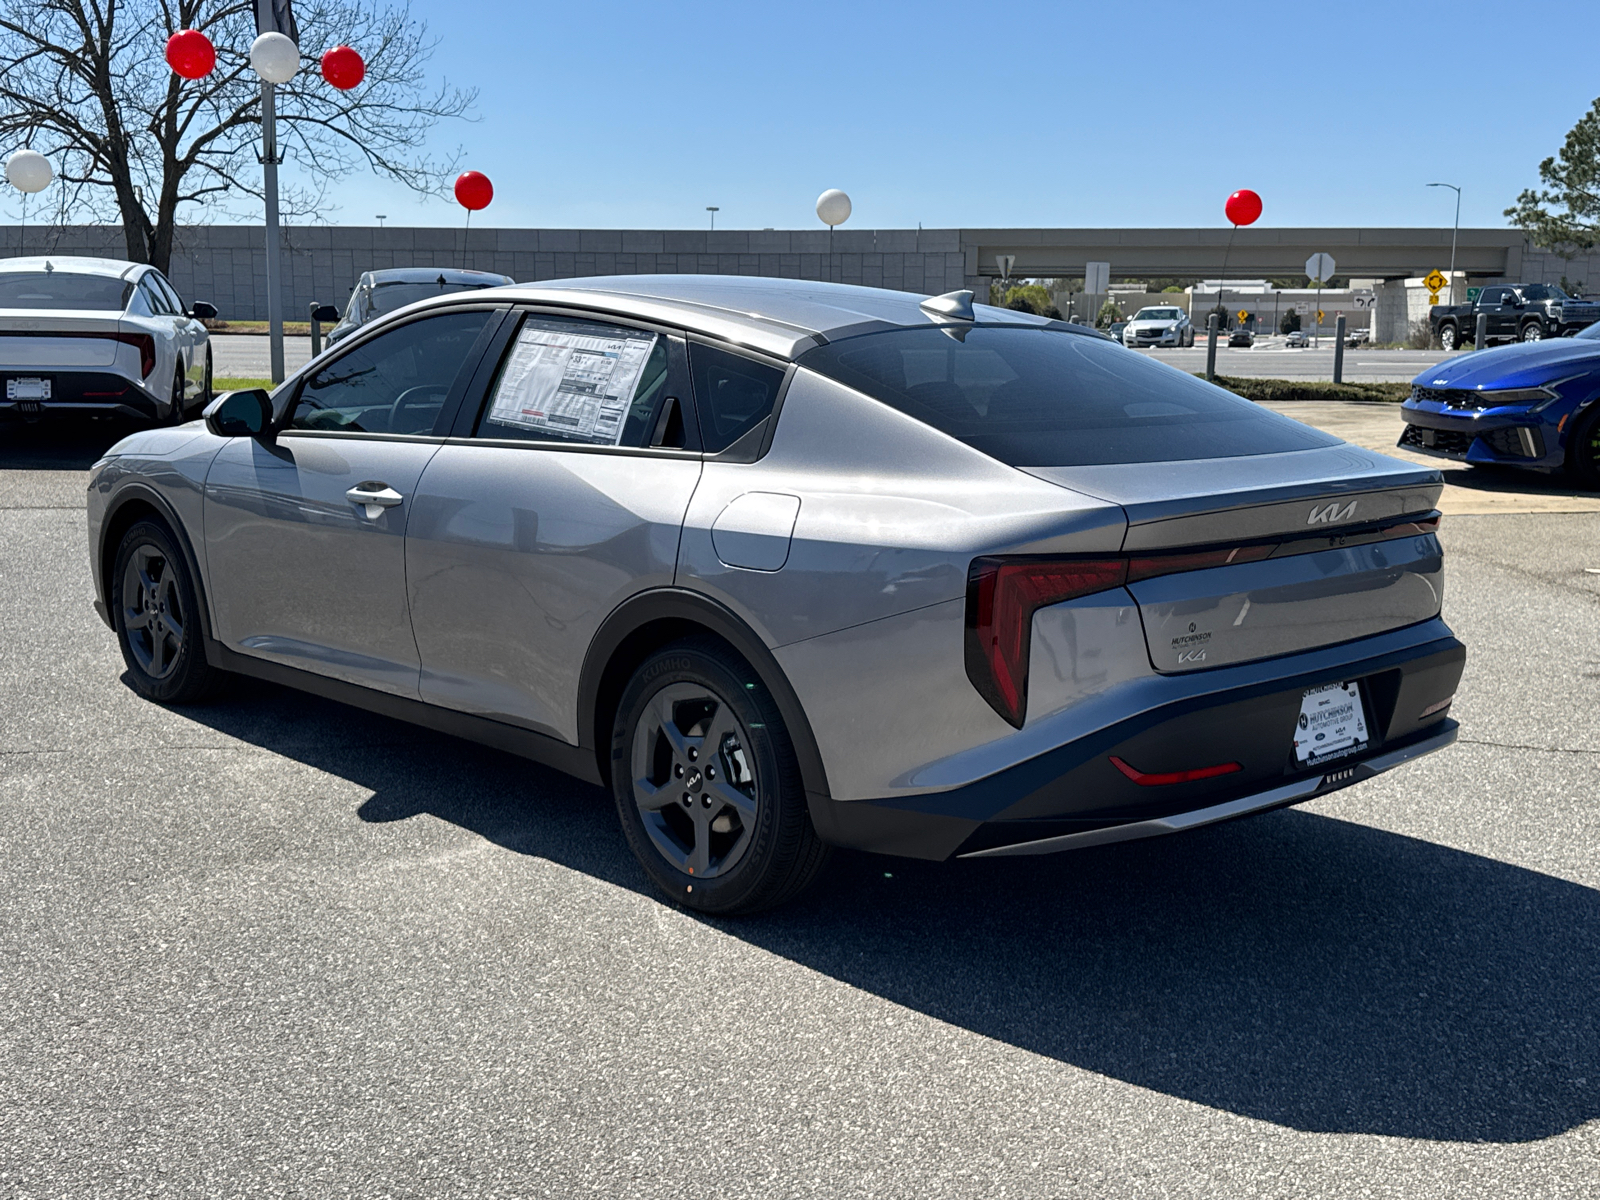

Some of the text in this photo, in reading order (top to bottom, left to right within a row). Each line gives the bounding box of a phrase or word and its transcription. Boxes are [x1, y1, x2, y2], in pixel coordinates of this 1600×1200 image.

[1307, 501, 1358, 525] KIA
[1171, 632, 1213, 645] HUTCHINSON
[1178, 648, 1207, 664] K4
[642, 657, 692, 684] KUMHO
[1310, 703, 1354, 724] HUTCHINSON
[1312, 713, 1354, 731] AUTOMOTIVE GROUP
[686, 773, 701, 788] KIA
[751, 793, 772, 866] SOLUS
